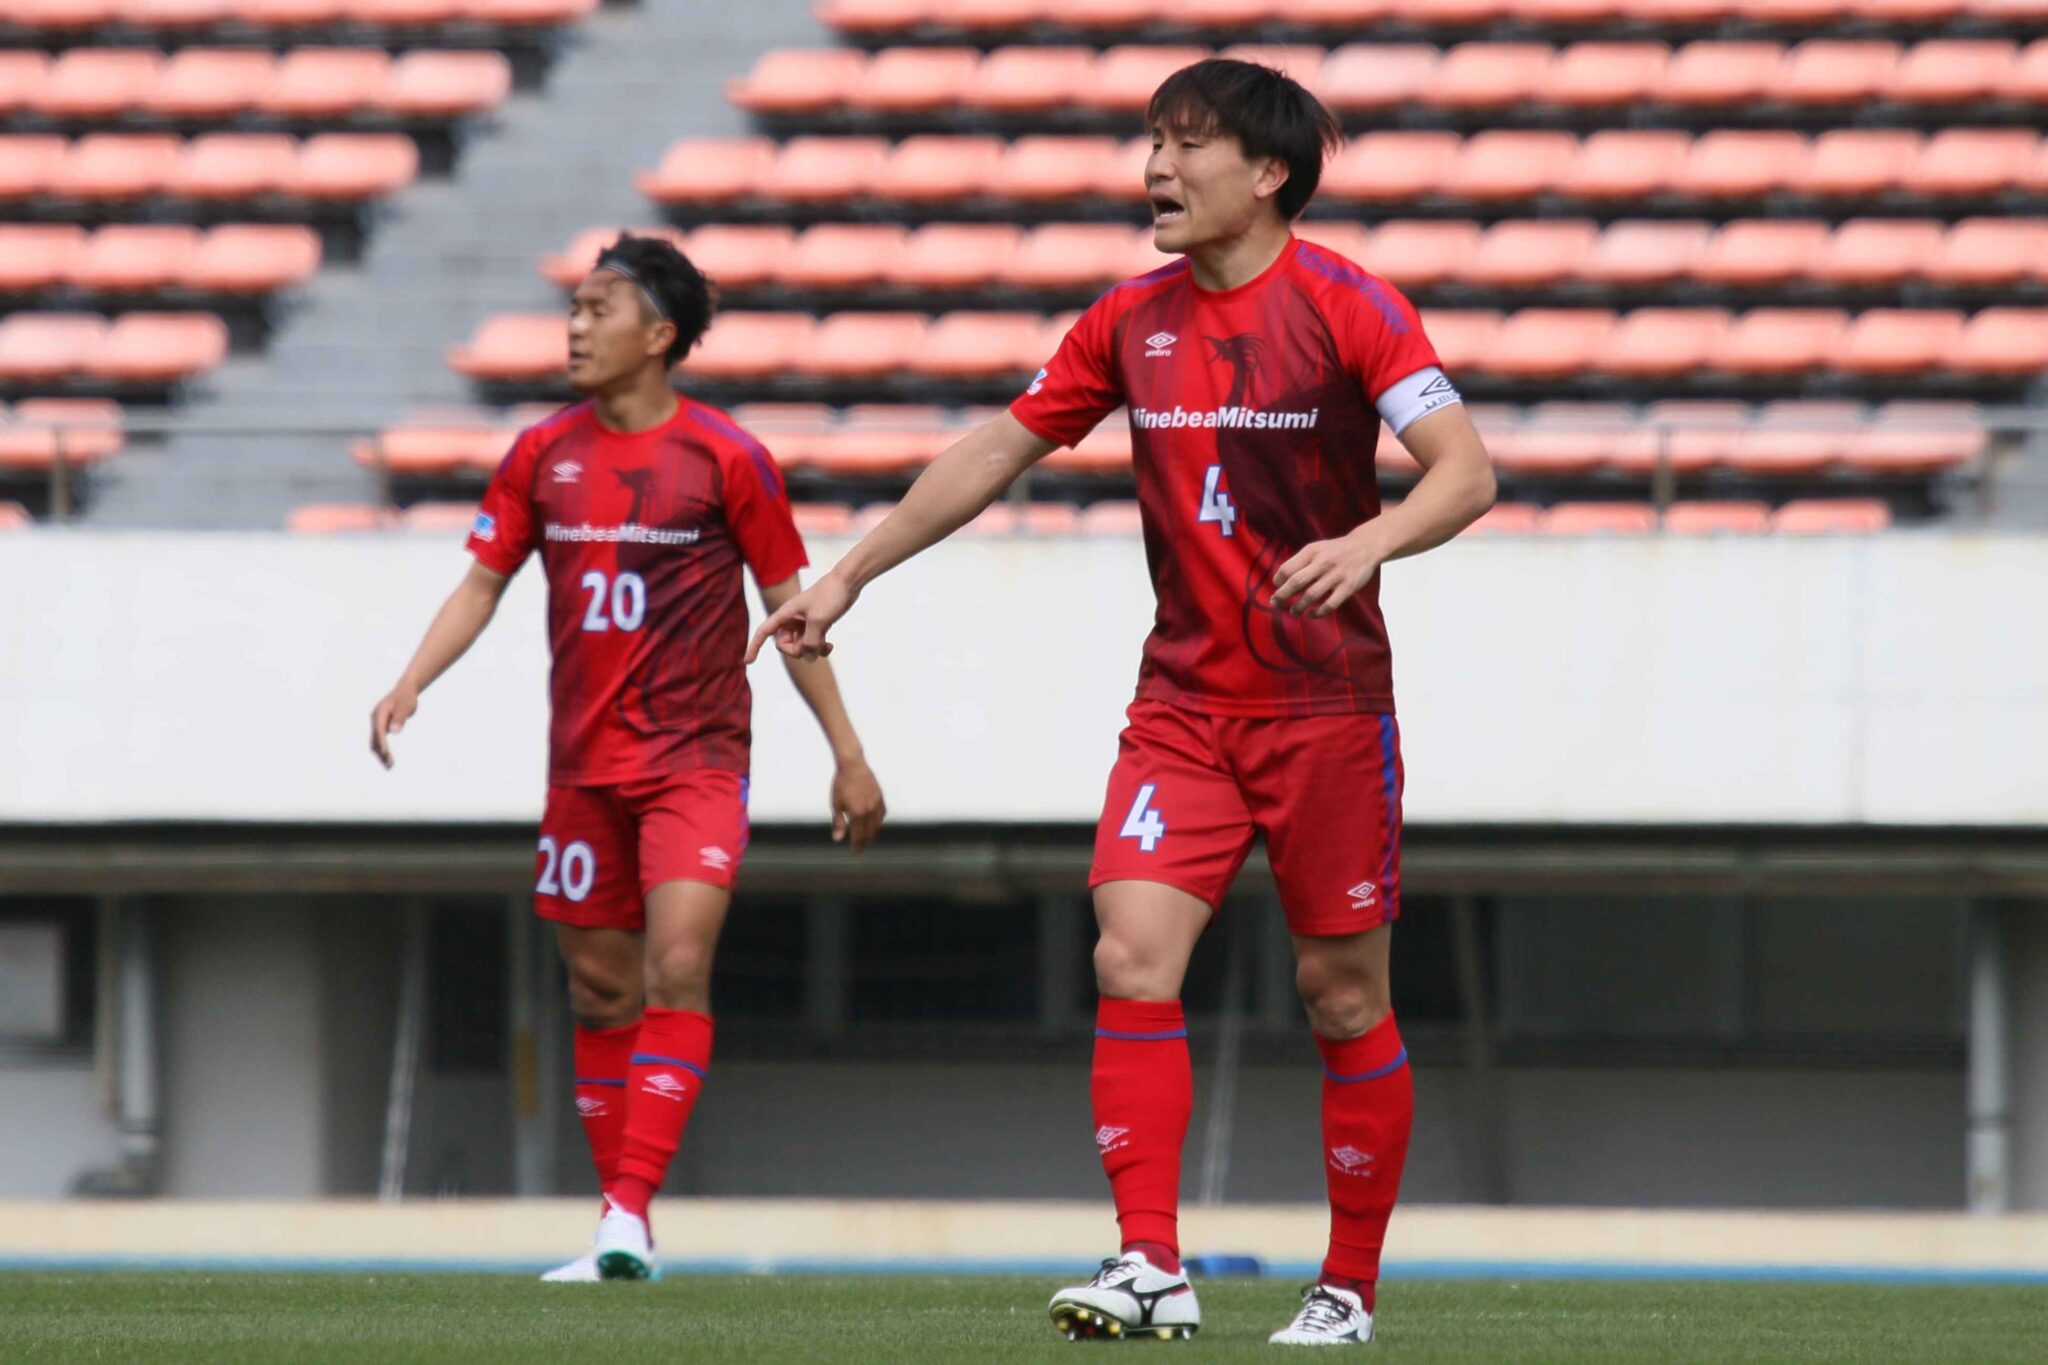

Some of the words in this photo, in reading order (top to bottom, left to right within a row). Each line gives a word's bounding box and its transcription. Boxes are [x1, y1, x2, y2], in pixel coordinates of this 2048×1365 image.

[1198, 465, 1236, 537] 4
[580, 570, 647, 633] 20
[1118, 783, 1166, 853] 4
[535, 836, 595, 903] 20
